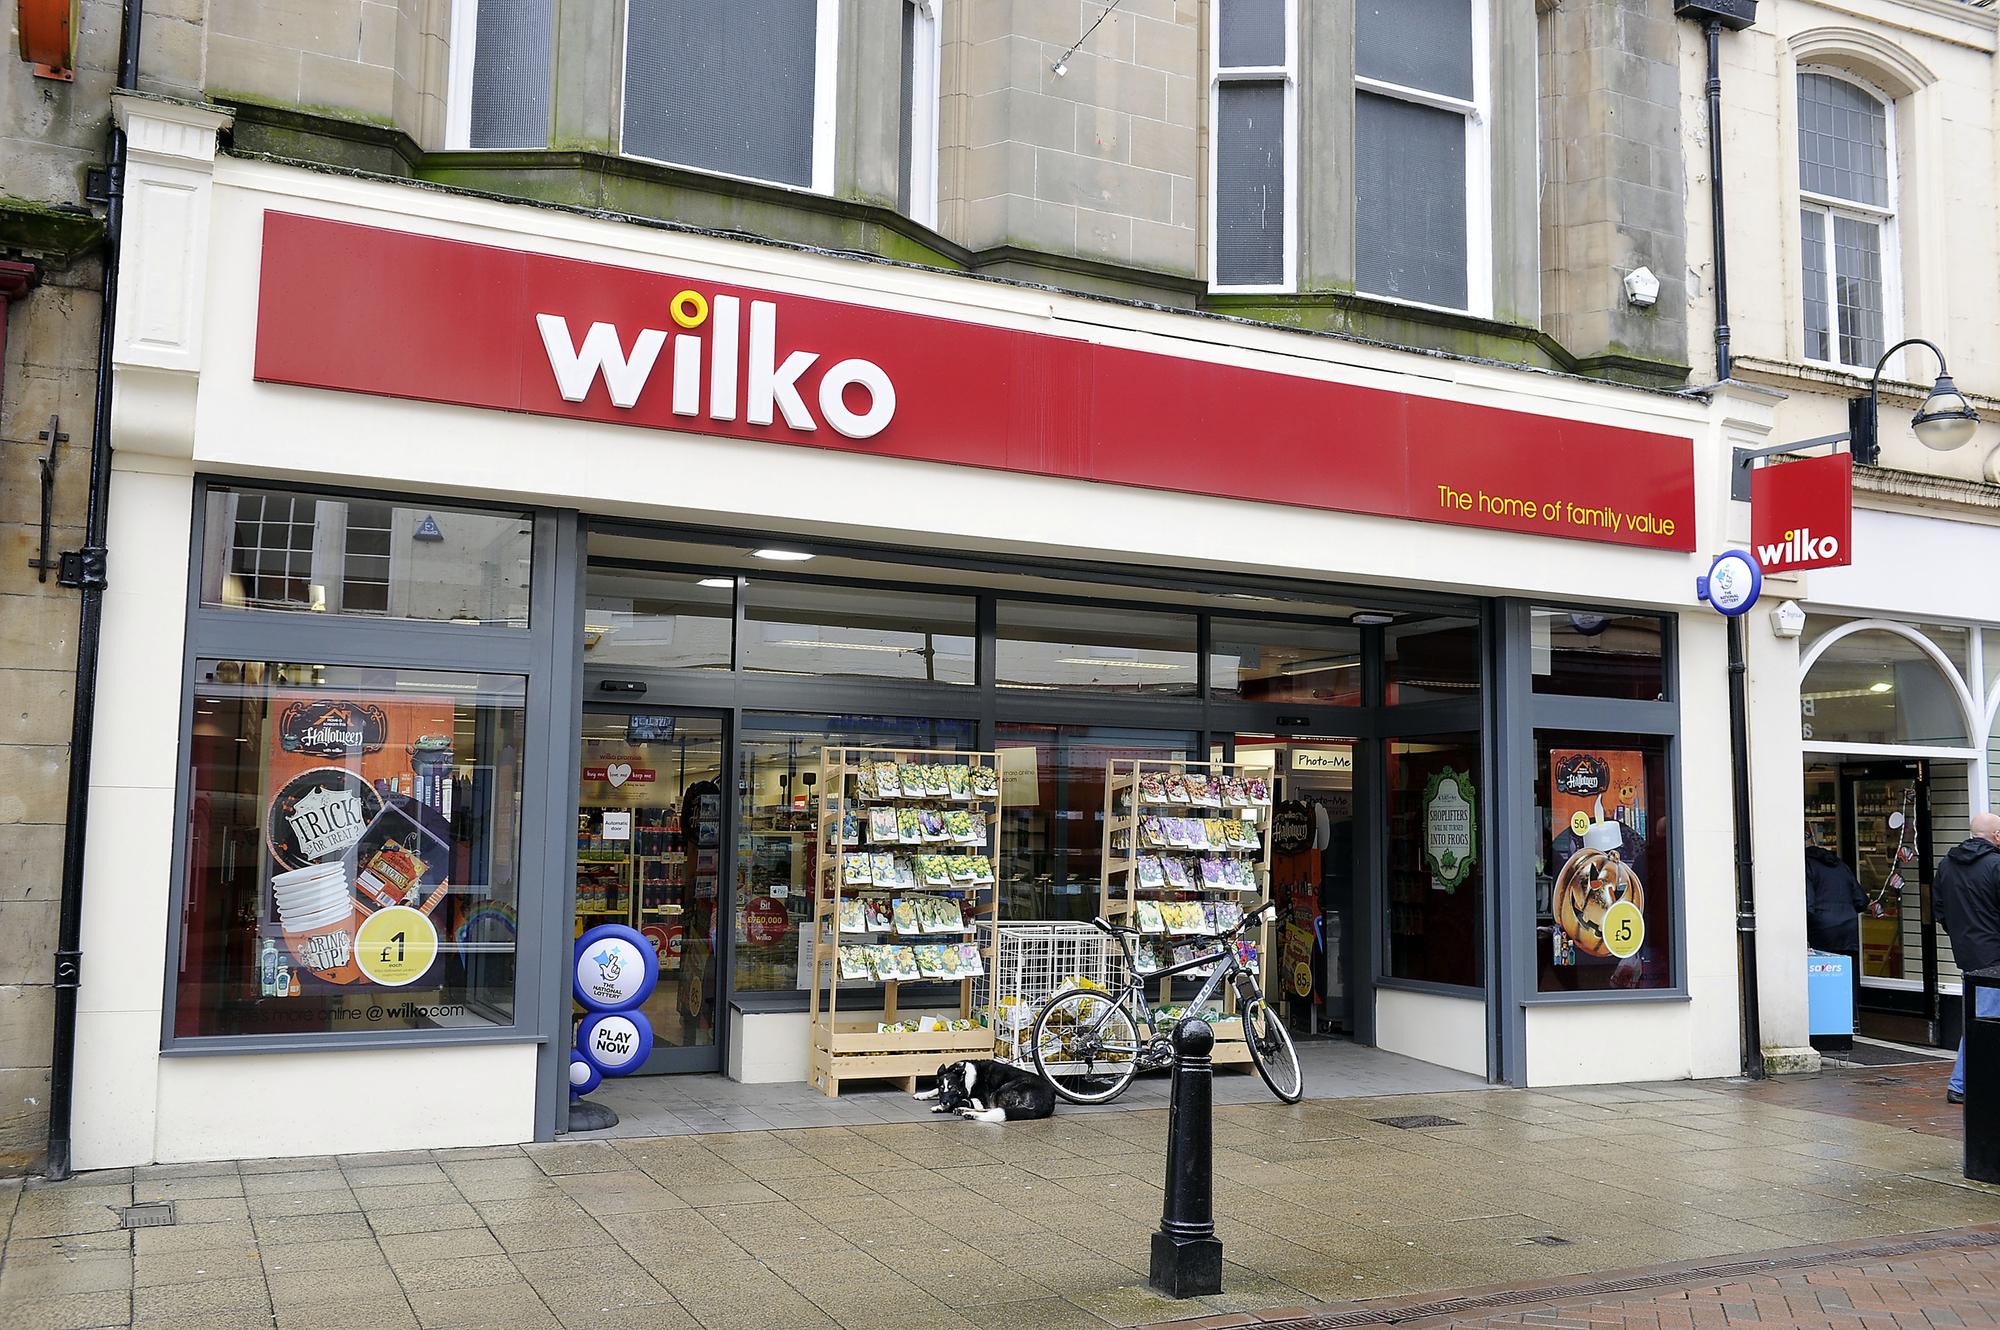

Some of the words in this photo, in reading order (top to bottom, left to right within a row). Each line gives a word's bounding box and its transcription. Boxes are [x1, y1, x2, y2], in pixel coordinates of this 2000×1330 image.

[535, 290, 897, 439] wilko
[1437, 485, 1473, 511] The
[1479, 491, 1537, 518] home
[1542, 500, 1562, 522] of
[1567, 503, 1622, 533] family
[1626, 513, 1676, 537] value
[1757, 528, 1839, 566] wilko
[301, 727, 364, 747] Halloween
[1298, 754, 1352, 767] Photo-Me
[1566, 774, 1599, 789] Halloween
[291, 798, 361, 843] TRICK
[1429, 809, 1468, 822] SHOPLIFTERS
[1574, 819, 1588, 830] 50p
[313, 840, 327, 852] OR
[327, 828, 354, 846] TREAT
[1430, 833, 1447, 845] INTO
[1447, 833, 1469, 845] FROGS
[1615, 919, 1632, 942] £5
[309, 930, 347, 954] DRINK
[380, 932, 405, 962] £1
[317, 948, 346, 970] UP!
[1809, 963, 1843, 973] savers
[1296, 973, 1311, 989] 85p
[593, 985, 622, 996] NATIONAL
[593, 990, 621, 999] LOTTERY
[319, 1006, 362, 1020] online
[365, 1005, 384, 1022] @
[386, 1002, 465, 1018] wilko.com
[599, 1028, 633, 1044] PLAY
[596, 1040, 630, 1055] NOW
